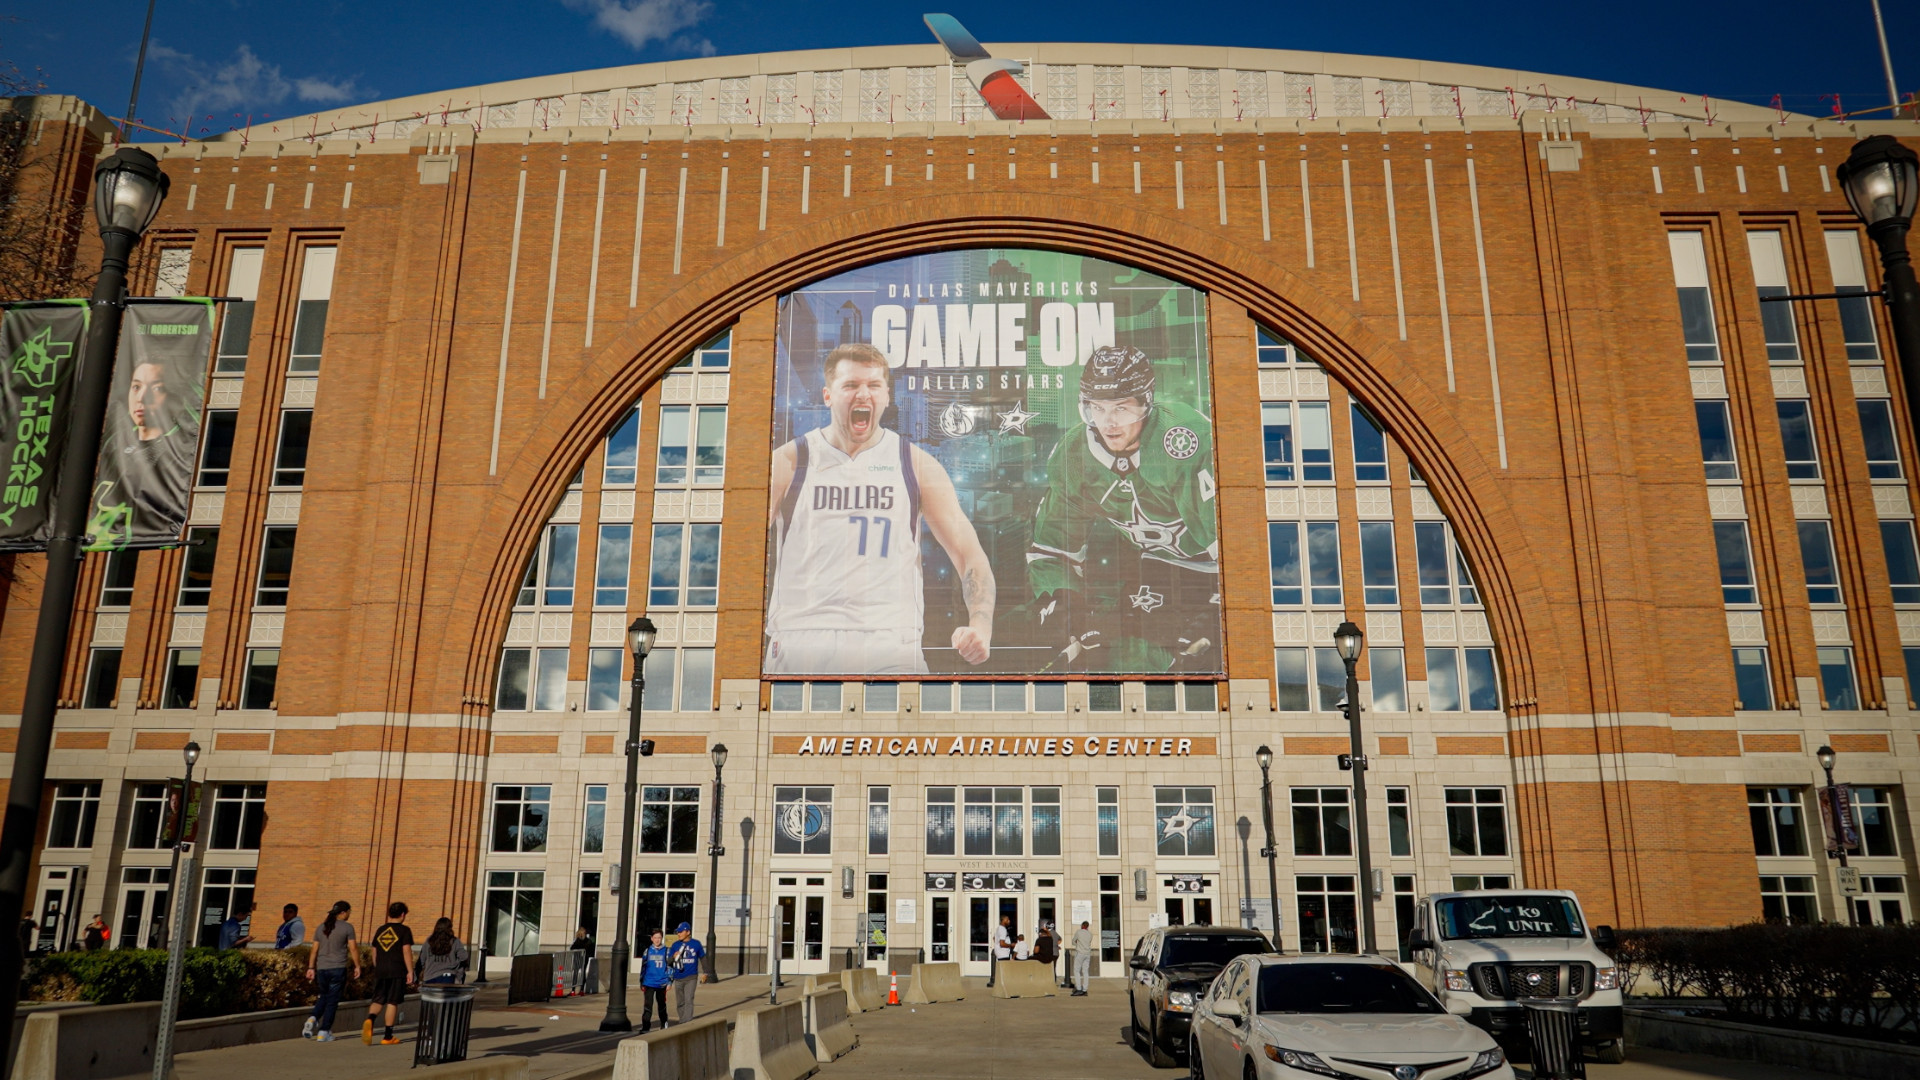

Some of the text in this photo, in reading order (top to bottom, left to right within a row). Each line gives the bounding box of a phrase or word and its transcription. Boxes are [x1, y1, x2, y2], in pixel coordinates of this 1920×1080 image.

[888, 281, 1099, 298] DALLAS MAVERICKS
[870, 301, 1117, 369] GAME ON
[908, 373, 1065, 391] DALLAS STARS
[20, 394, 55, 508] TEXAS
[0, 396, 38, 527] HOCKEY
[813, 485, 894, 511] DALLAS
[849, 516, 892, 558] 77
[798, 735, 1192, 755] AMERICAN AIRLINES CENTER
[959, 861, 1029, 869] WEST ENTRANCE
[1517, 905, 1541, 918] K9
[1508, 920, 1553, 933] UNIT
